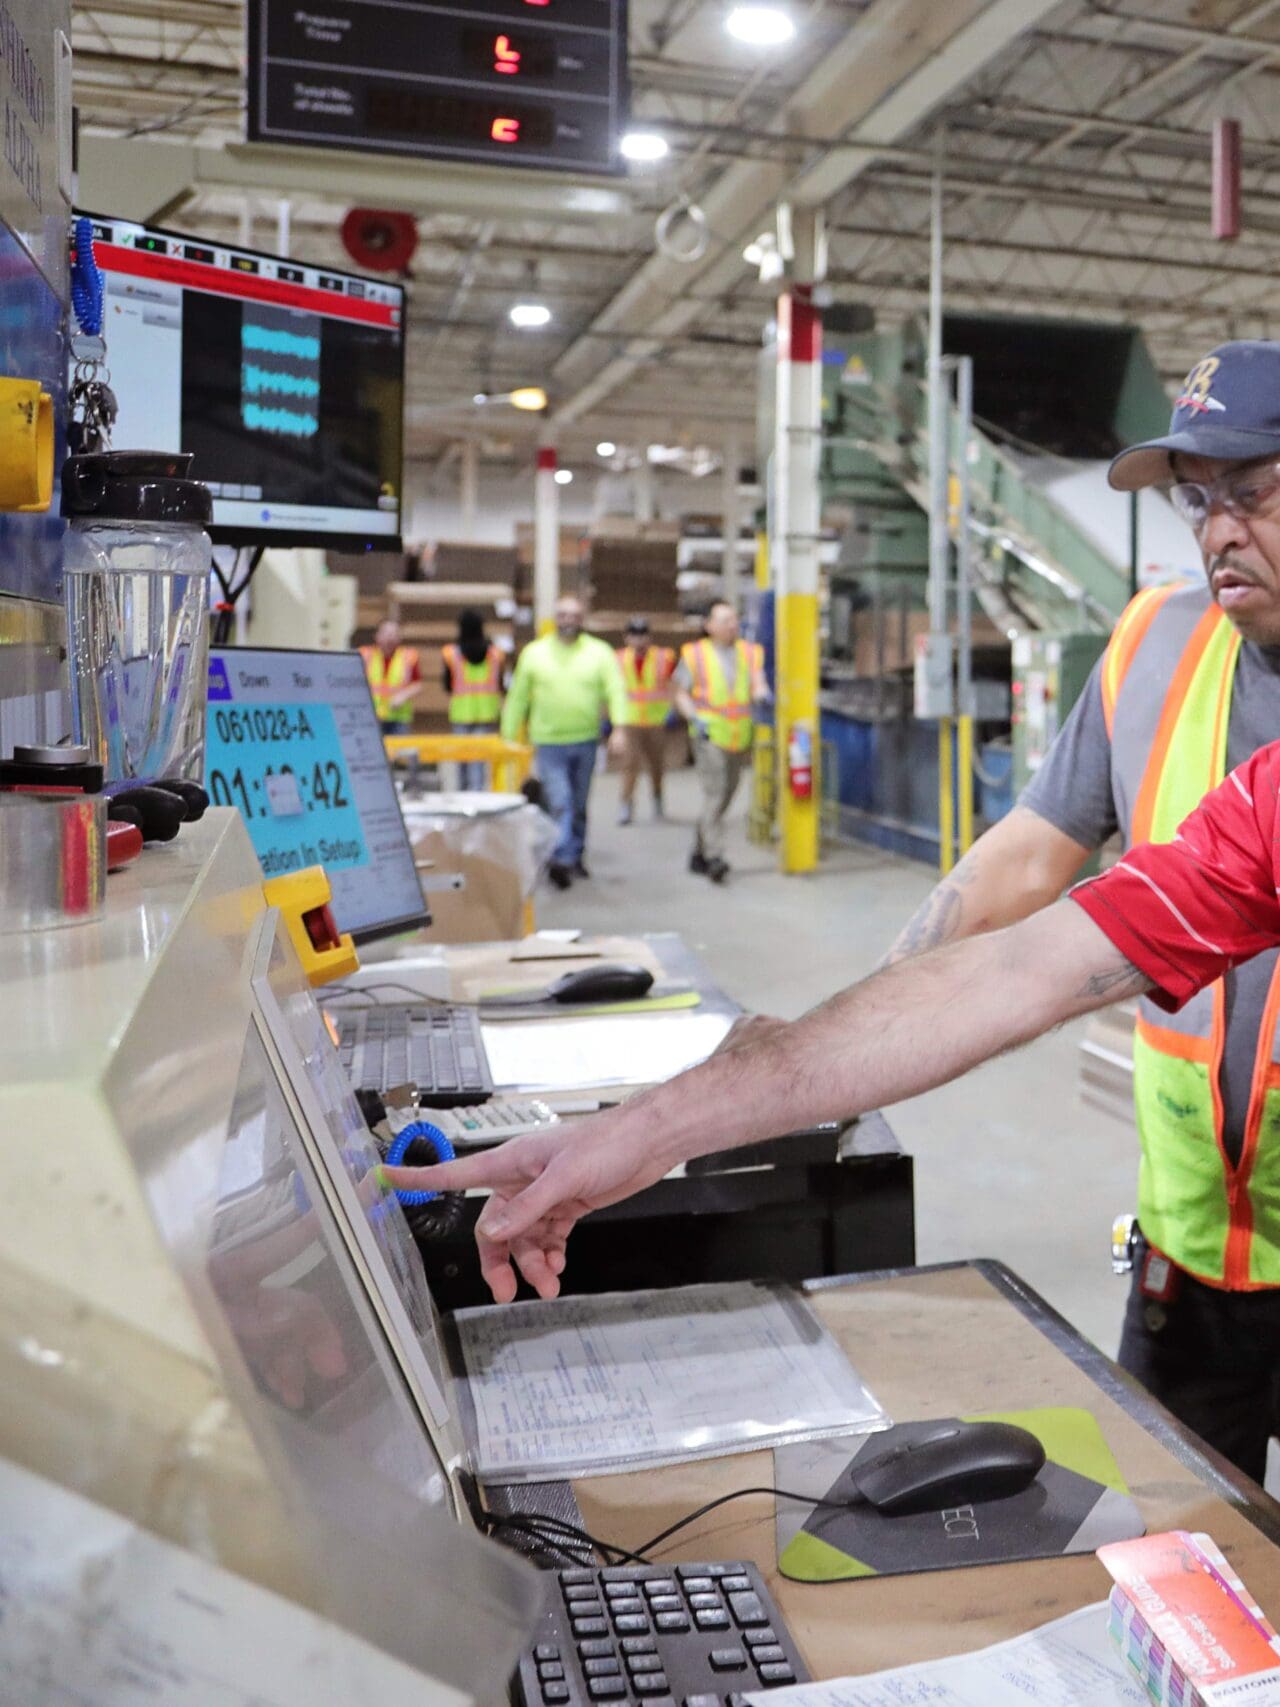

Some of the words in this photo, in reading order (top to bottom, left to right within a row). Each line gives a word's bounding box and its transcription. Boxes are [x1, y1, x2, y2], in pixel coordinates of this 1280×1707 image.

[239, 671, 271, 689] Down
[292, 671, 313, 688] Run
[216, 709, 314, 743] 061028-A
[210, 761, 349, 820] 01::42
[319, 838, 362, 864] Setup
[1131, 1575, 1166, 1612] GUIDE
